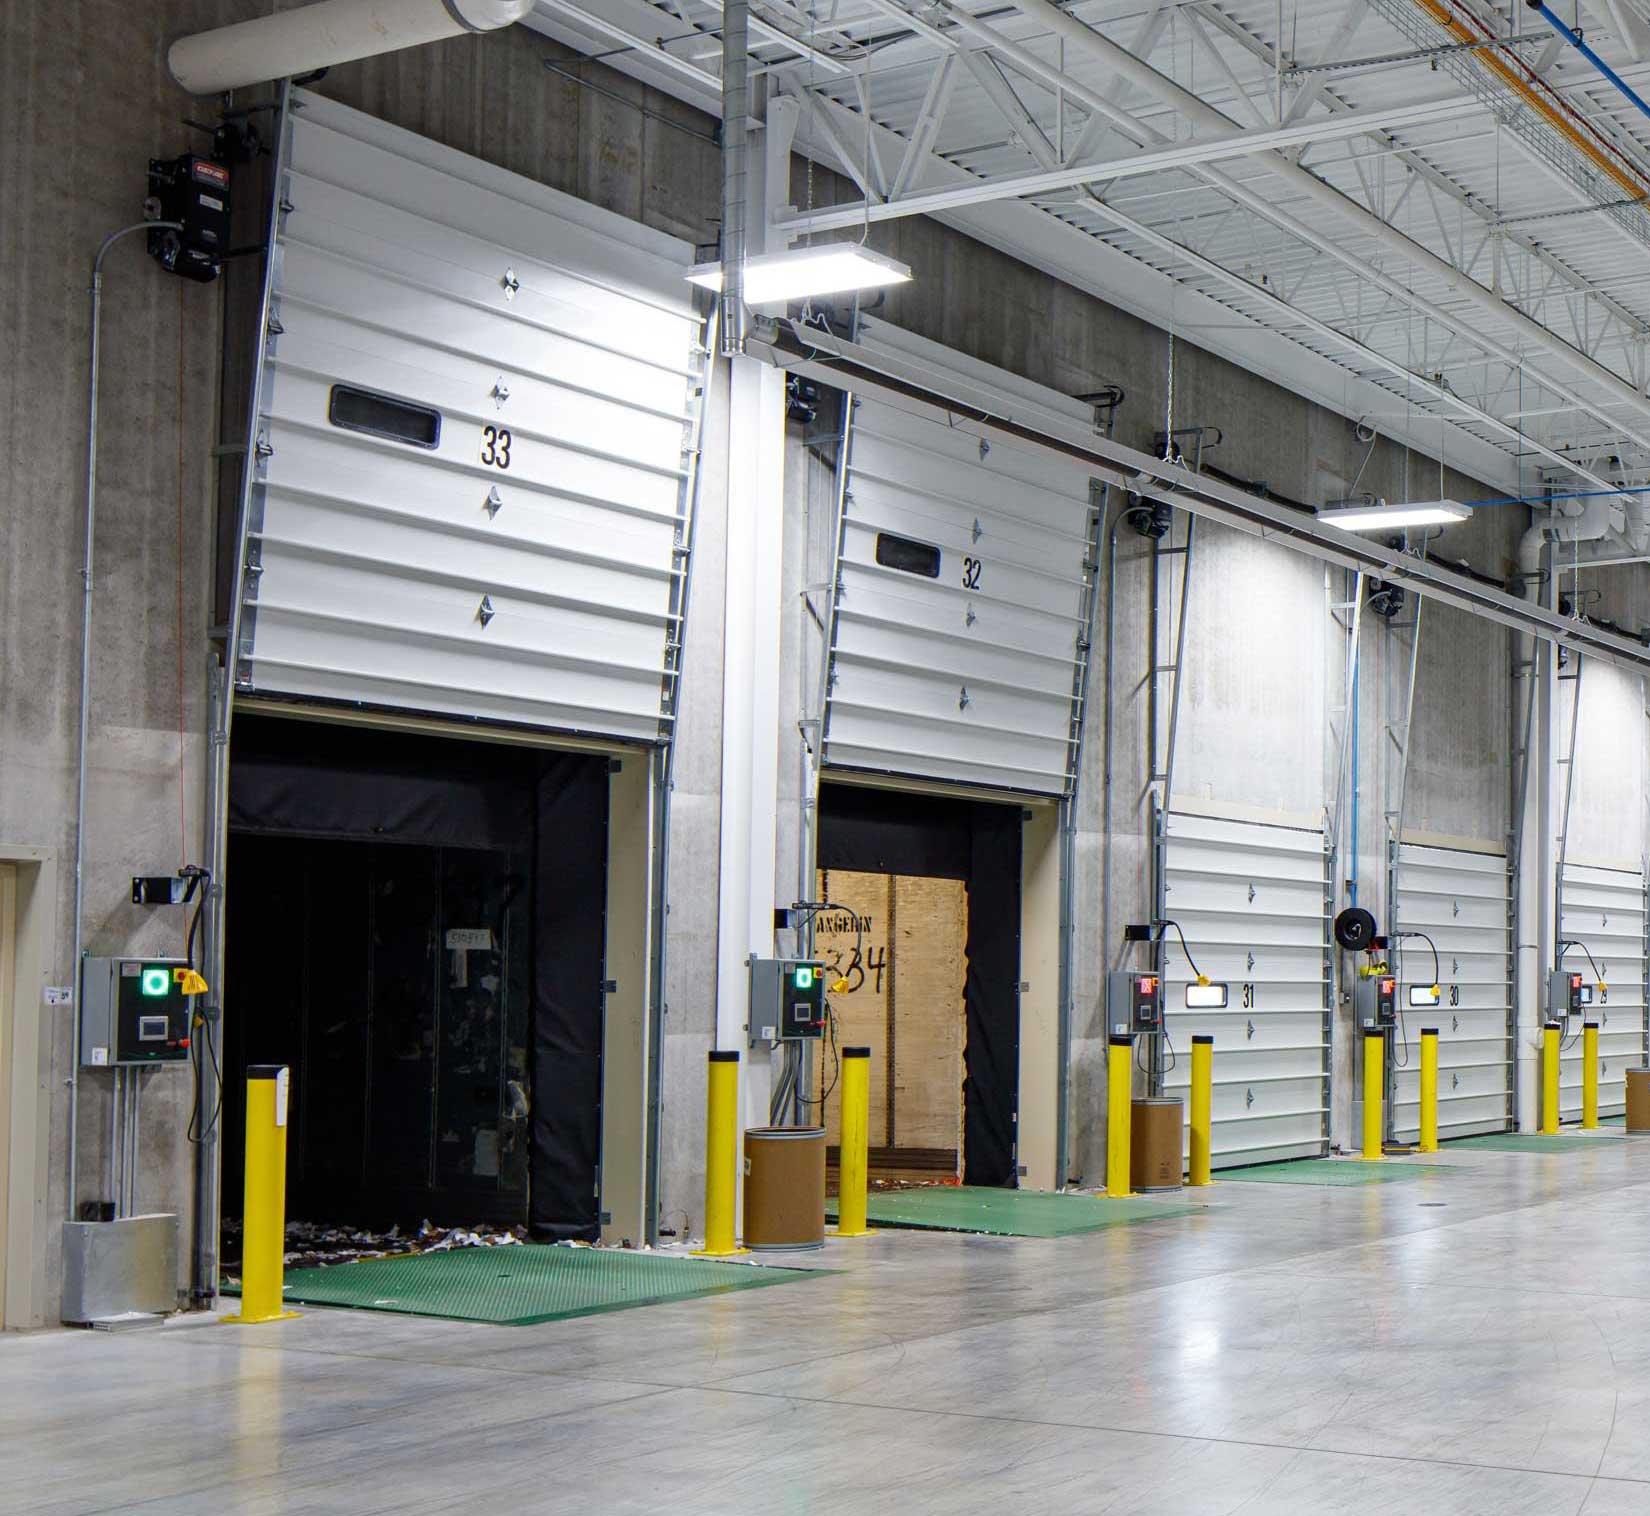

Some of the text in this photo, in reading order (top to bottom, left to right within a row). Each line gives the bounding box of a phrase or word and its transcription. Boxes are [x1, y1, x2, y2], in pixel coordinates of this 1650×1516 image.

[481, 425, 512, 469] 33
[962, 557, 982, 591] 32
[1243, 983, 1254, 1009] 31
[1449, 985, 1460, 1007] 30
